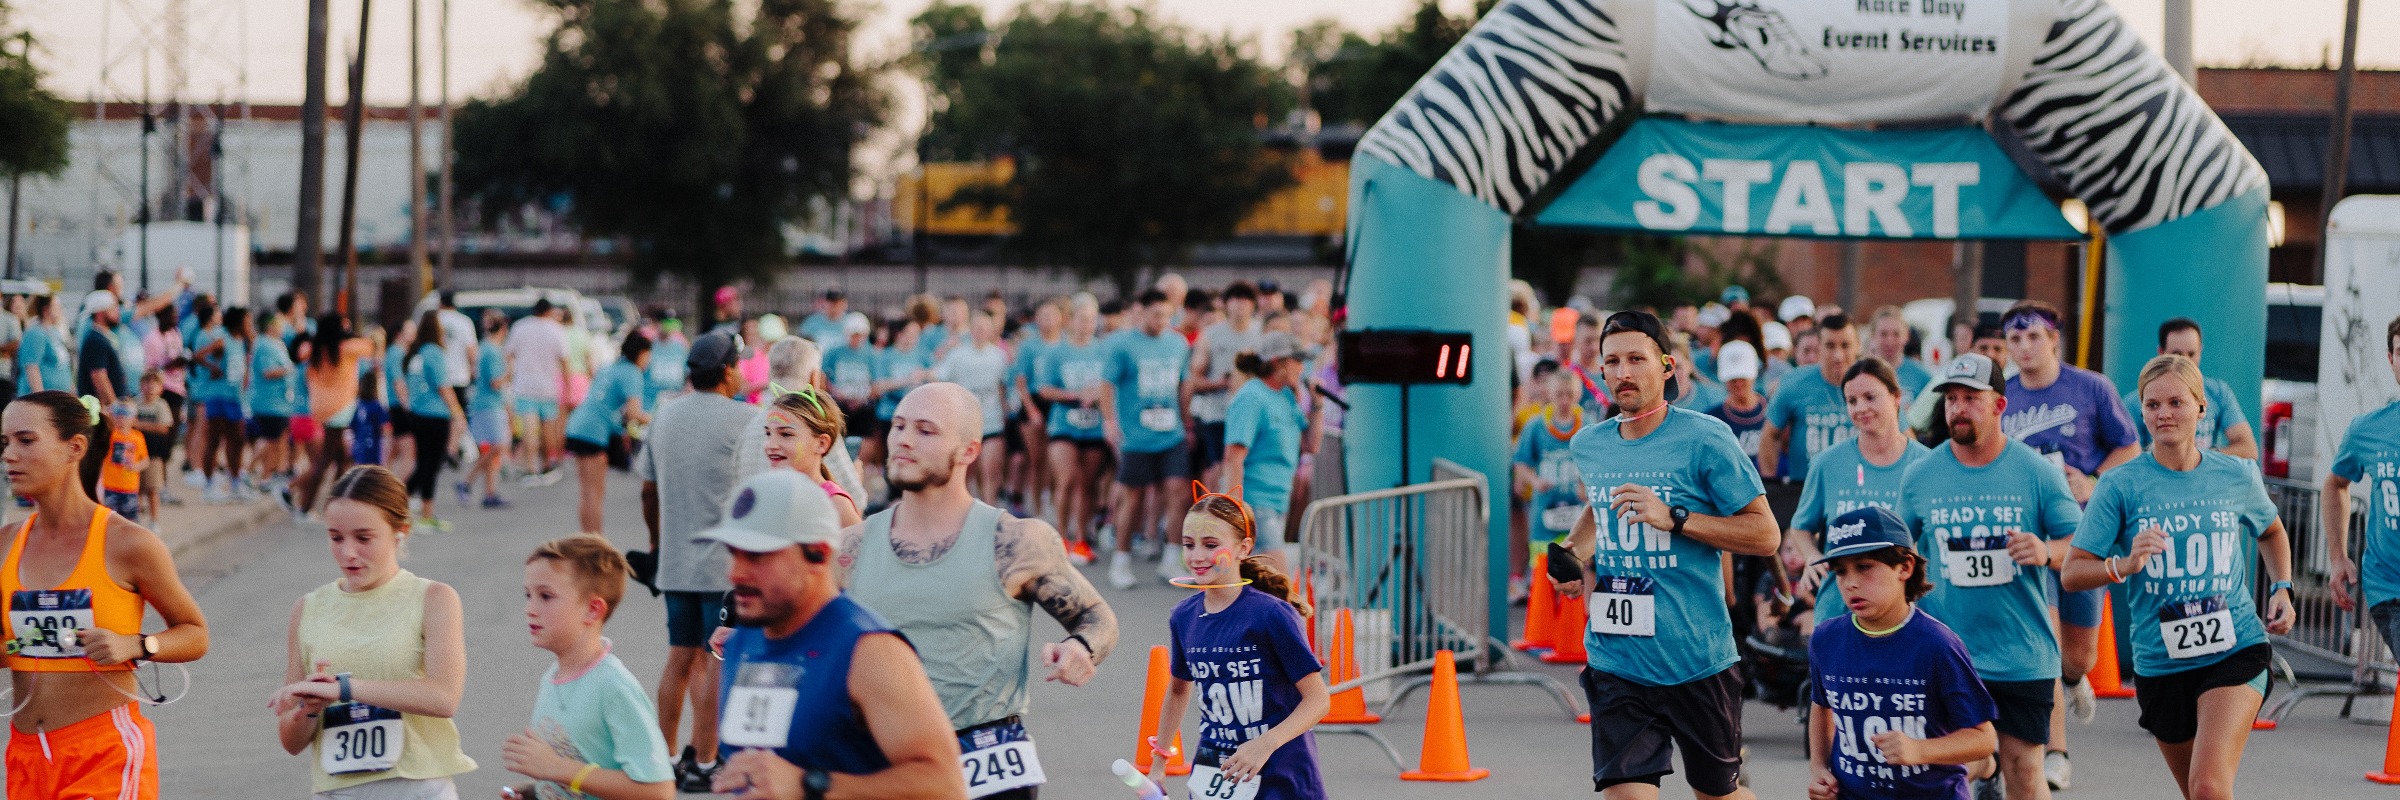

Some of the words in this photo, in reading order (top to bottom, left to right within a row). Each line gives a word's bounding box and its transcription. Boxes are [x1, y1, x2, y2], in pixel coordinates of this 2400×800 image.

[1857, 0, 1910, 14] Race
[1922, 0, 1965, 21] Day
[1823, 26, 1889, 49] Event
[1900, 31, 1997, 53] Services
[1632, 152, 1981, 239] START
[1436, 344, 1471, 378] 11
[1931, 505, 1987, 525] READY
[1993, 506, 2024, 523] SET
[2158, 501, 2186, 511] LOVE
[2210, 511, 2236, 529] SET
[1648, 554, 1678, 569] RUN
[1966, 554, 1994, 578] 39
[2144, 532, 2236, 580] GLOW
[2180, 578, 2206, 593] FUN
[1606, 598, 1633, 626] 40
[2173, 617, 2225, 651] 232
[1226, 658, 1262, 679] SET
[1890, 693, 1927, 712] SET
[333, 725, 386, 762] 300
[963, 747, 1026, 788] 249
[1205, 772, 1239, 800] 93
